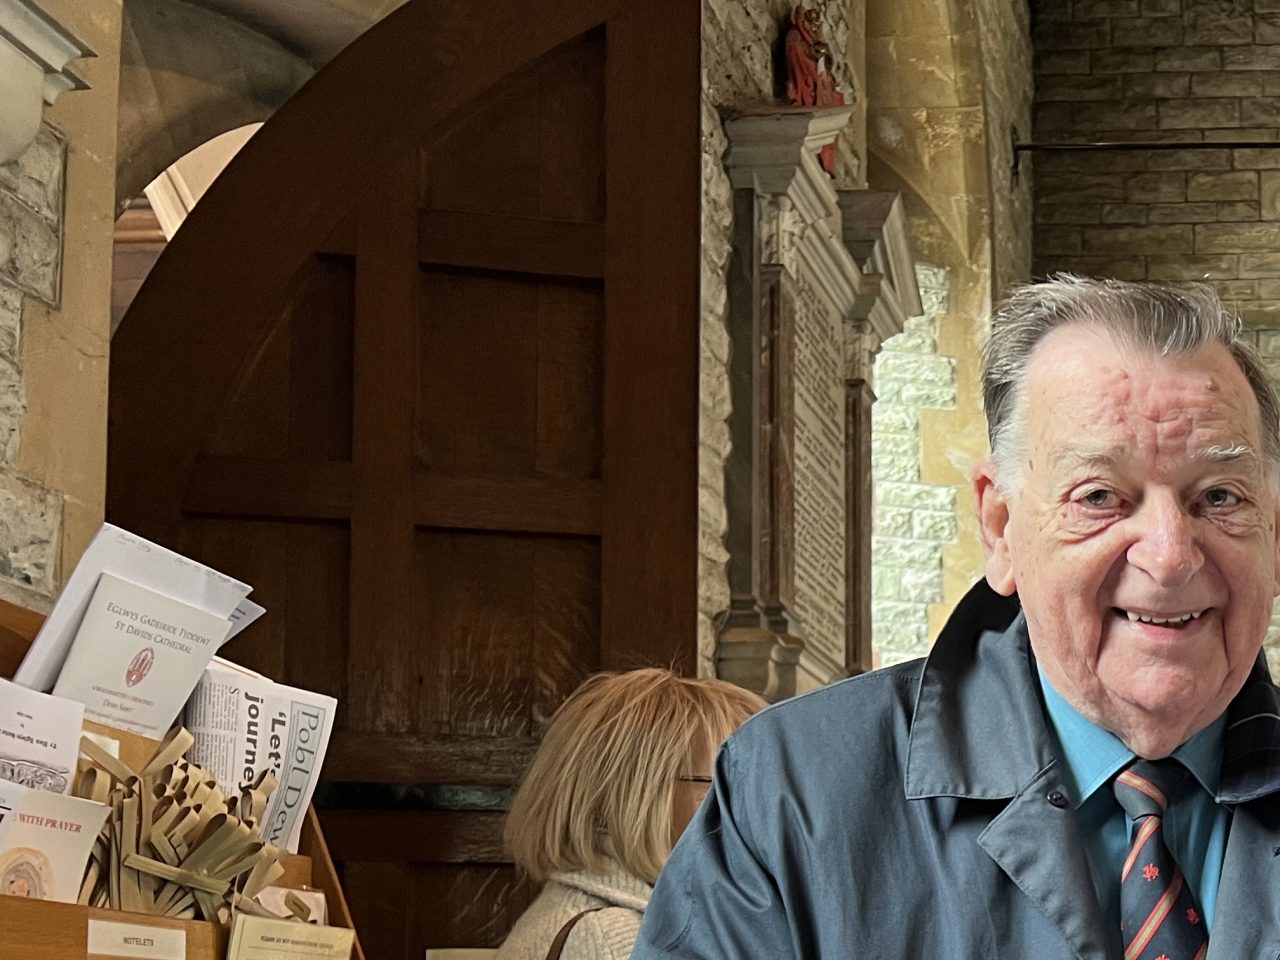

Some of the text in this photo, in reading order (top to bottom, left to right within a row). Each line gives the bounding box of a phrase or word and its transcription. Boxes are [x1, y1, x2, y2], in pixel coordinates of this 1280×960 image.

[270, 711, 320, 846] Pobl Dew
[19, 813, 82, 833] WITH PRAYER
[123, 936, 154, 947] NOTELETS
